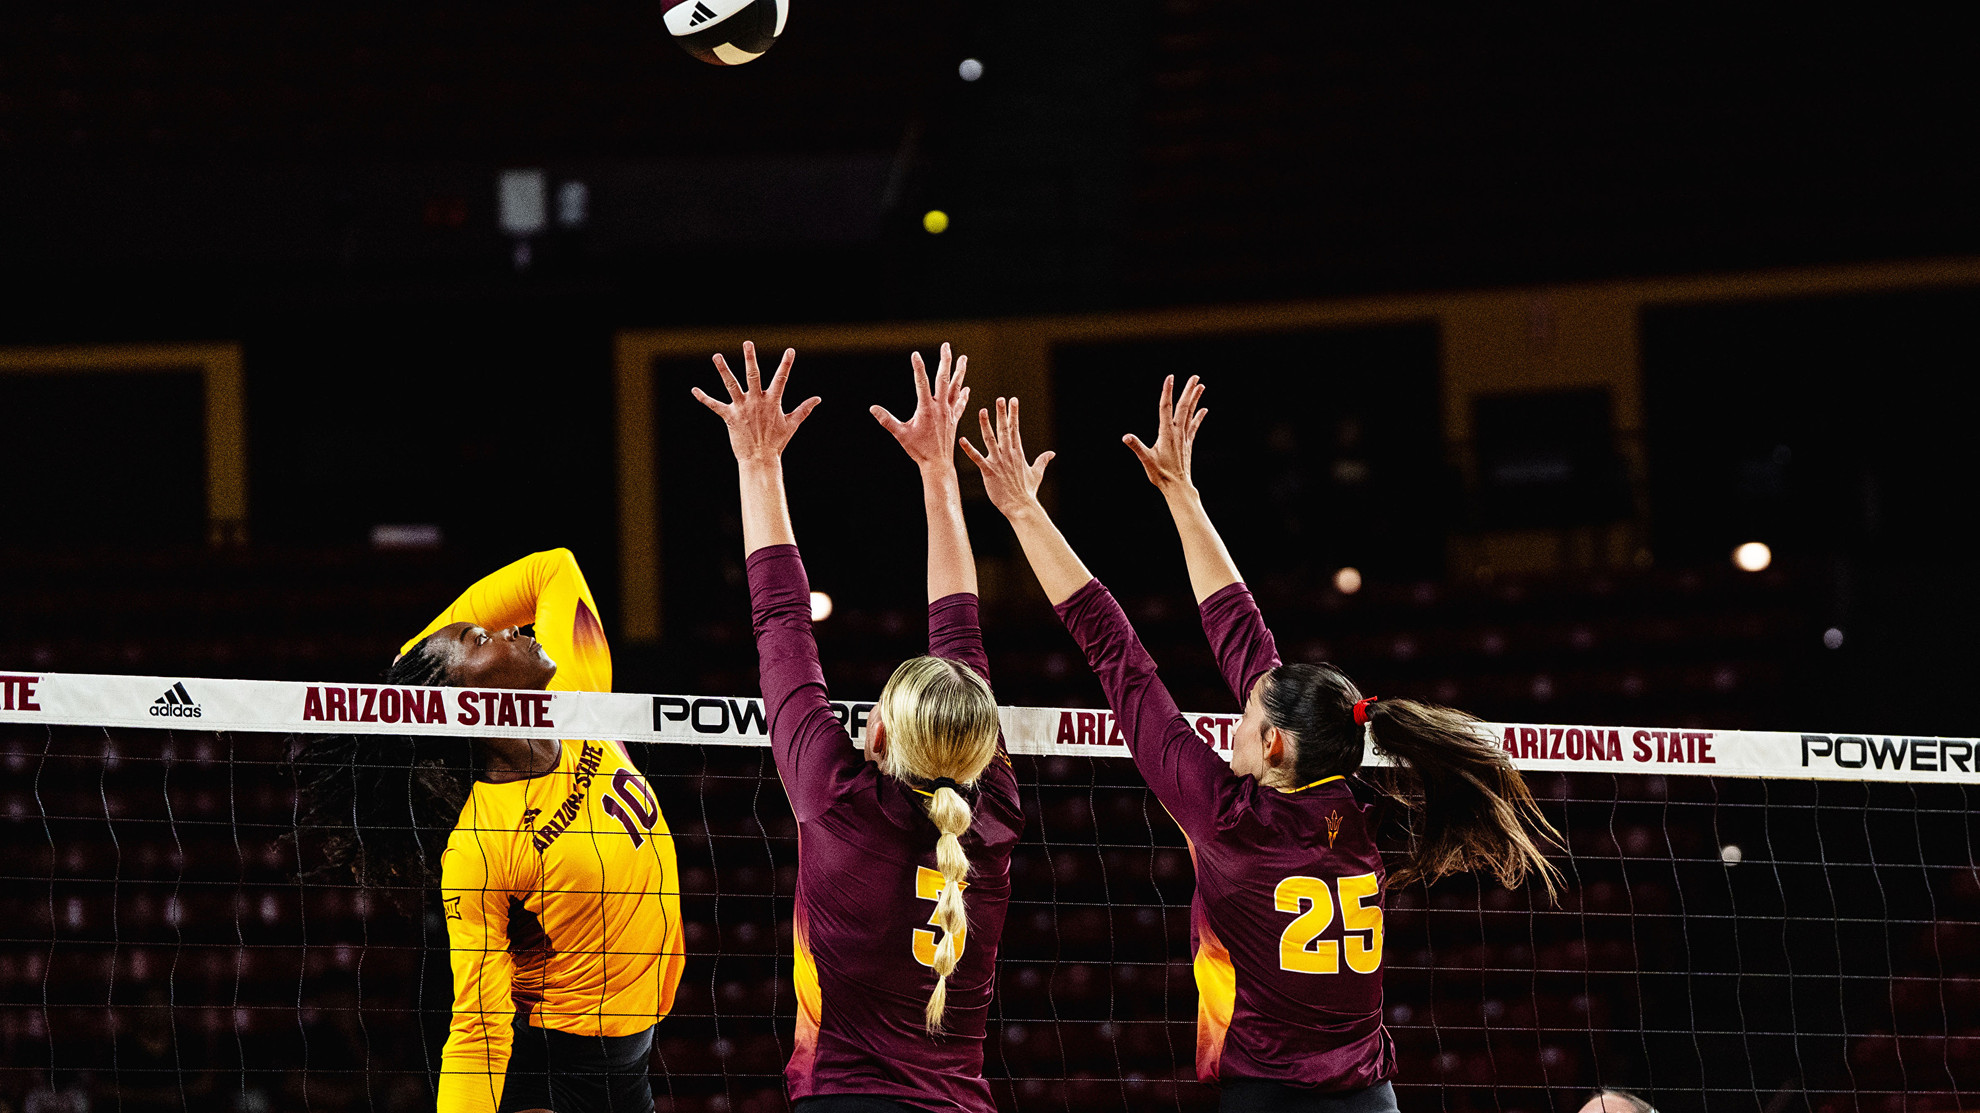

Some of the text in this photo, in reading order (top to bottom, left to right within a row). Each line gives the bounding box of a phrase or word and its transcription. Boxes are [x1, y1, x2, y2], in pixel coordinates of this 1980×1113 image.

[0, 675, 41, 711] TE
[149, 703, 202, 718] adidas
[304, 686, 555, 728] ARIZONA STATE
[1056, 711, 1124, 746] ARIZ
[1502, 727, 1716, 763] ARIZONA STATE
[1801, 735, 1980, 773] POWER
[532, 740, 604, 855] ARIZONA STATE
[601, 768, 659, 850] 10
[912, 865, 971, 968] 3
[1274, 872, 1385, 974] 25
